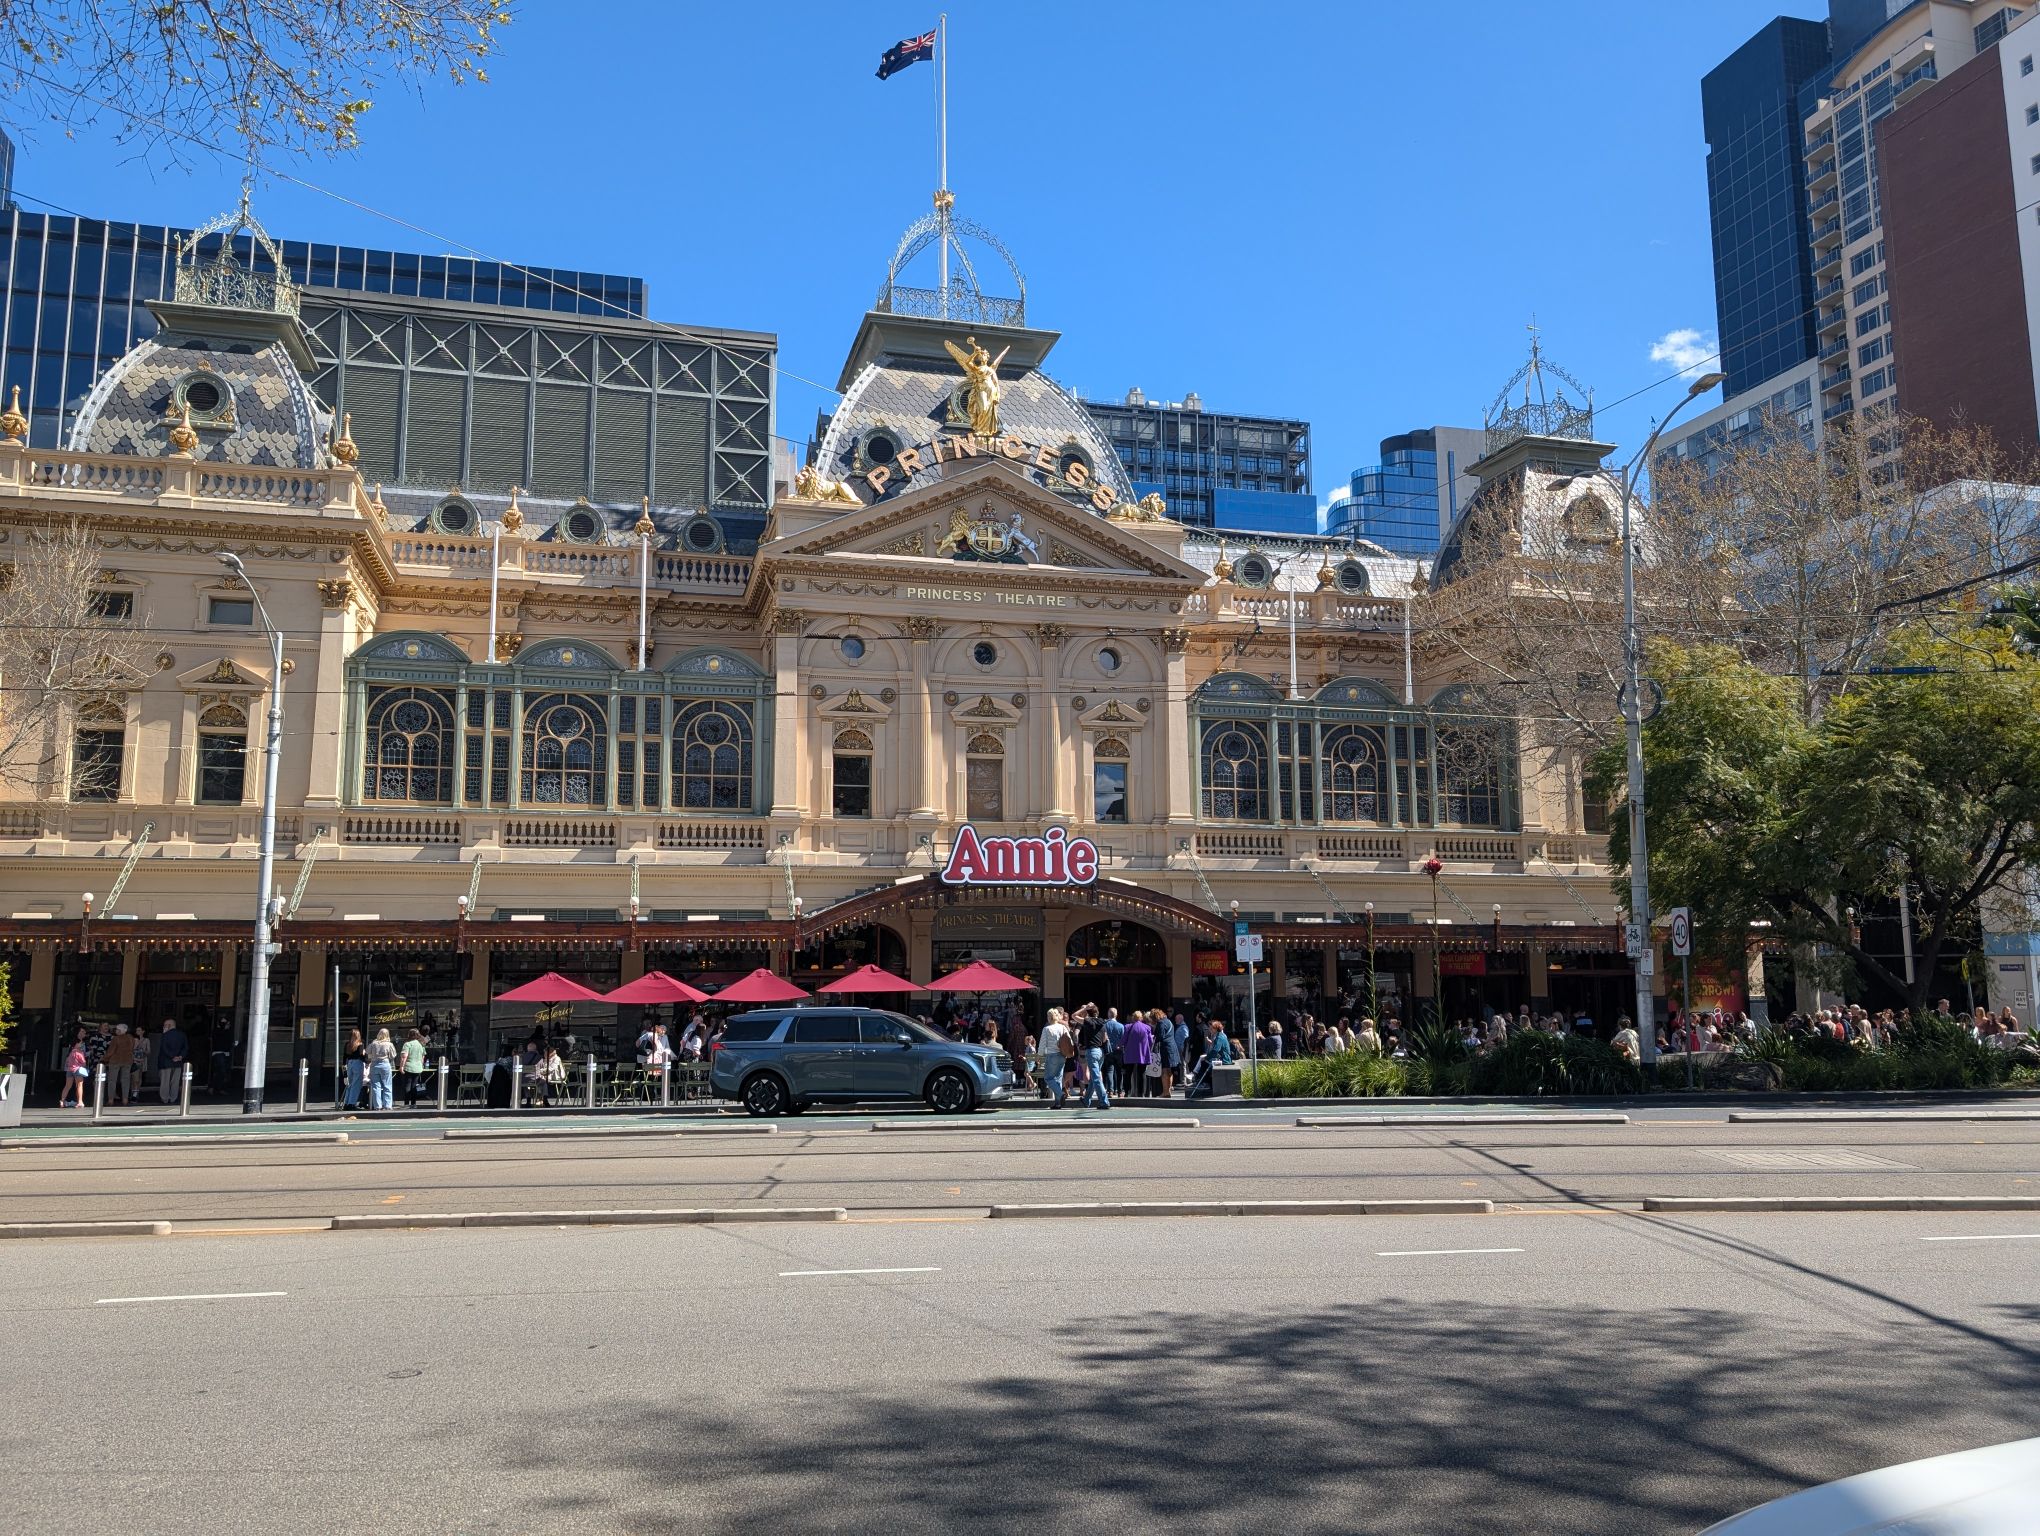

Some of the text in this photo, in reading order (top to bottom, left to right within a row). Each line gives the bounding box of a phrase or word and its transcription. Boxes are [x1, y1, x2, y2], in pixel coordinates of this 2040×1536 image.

[866, 432, 1117, 511] PRINCESS
[995, 592, 1067, 607] THEATRE
[942, 826, 1098, 885] Annie
[941, 912, 1037, 928] PRINCESS THEATRE
[1675, 923, 1686, 940] 40
[1628, 944, 1641, 954] LANE
[374, 1006, 416, 1024] Federici
